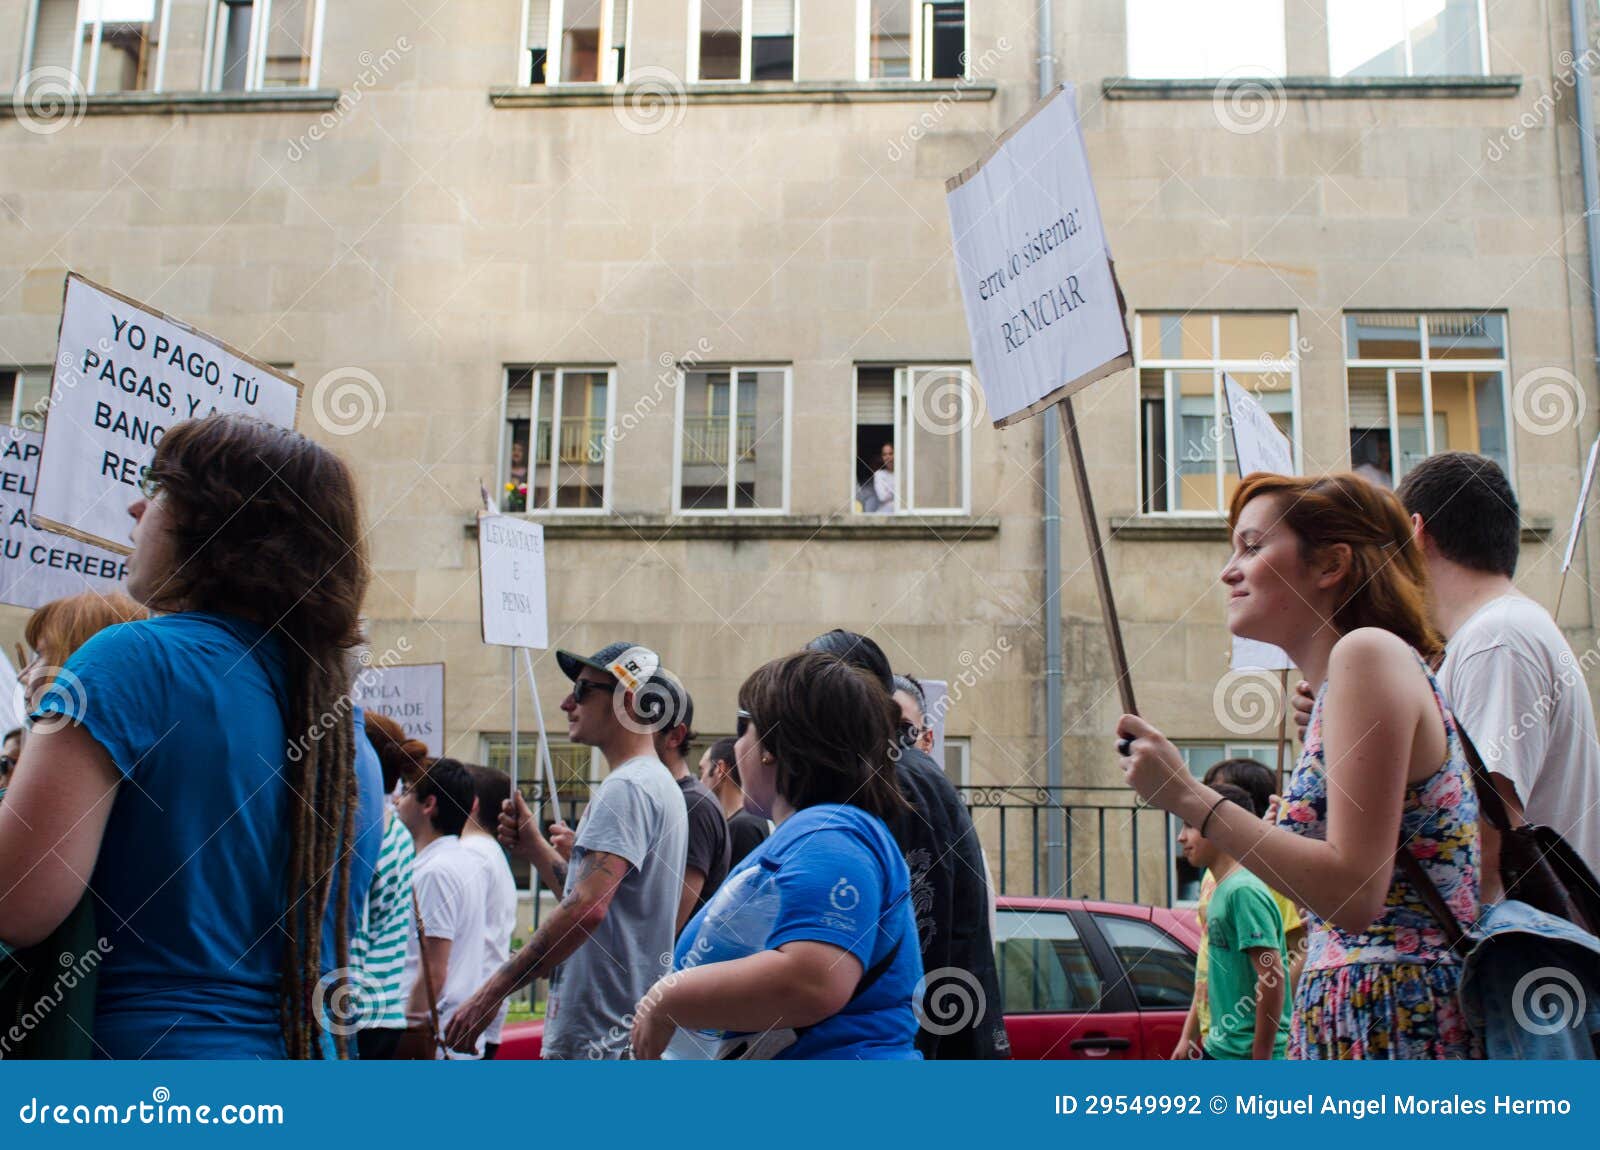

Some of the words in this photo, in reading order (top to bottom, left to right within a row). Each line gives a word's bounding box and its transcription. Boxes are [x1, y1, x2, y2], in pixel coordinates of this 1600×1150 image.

[82, 348, 176, 416] PAGAS,
[187, 393, 201, 419] Y
[111, 314, 146, 351] YO
[153, 335, 225, 394] PAGO,
[232, 376, 260, 405] TÚ
[0, 471, 34, 496] EL
[366, 702, 425, 717] IDADE
